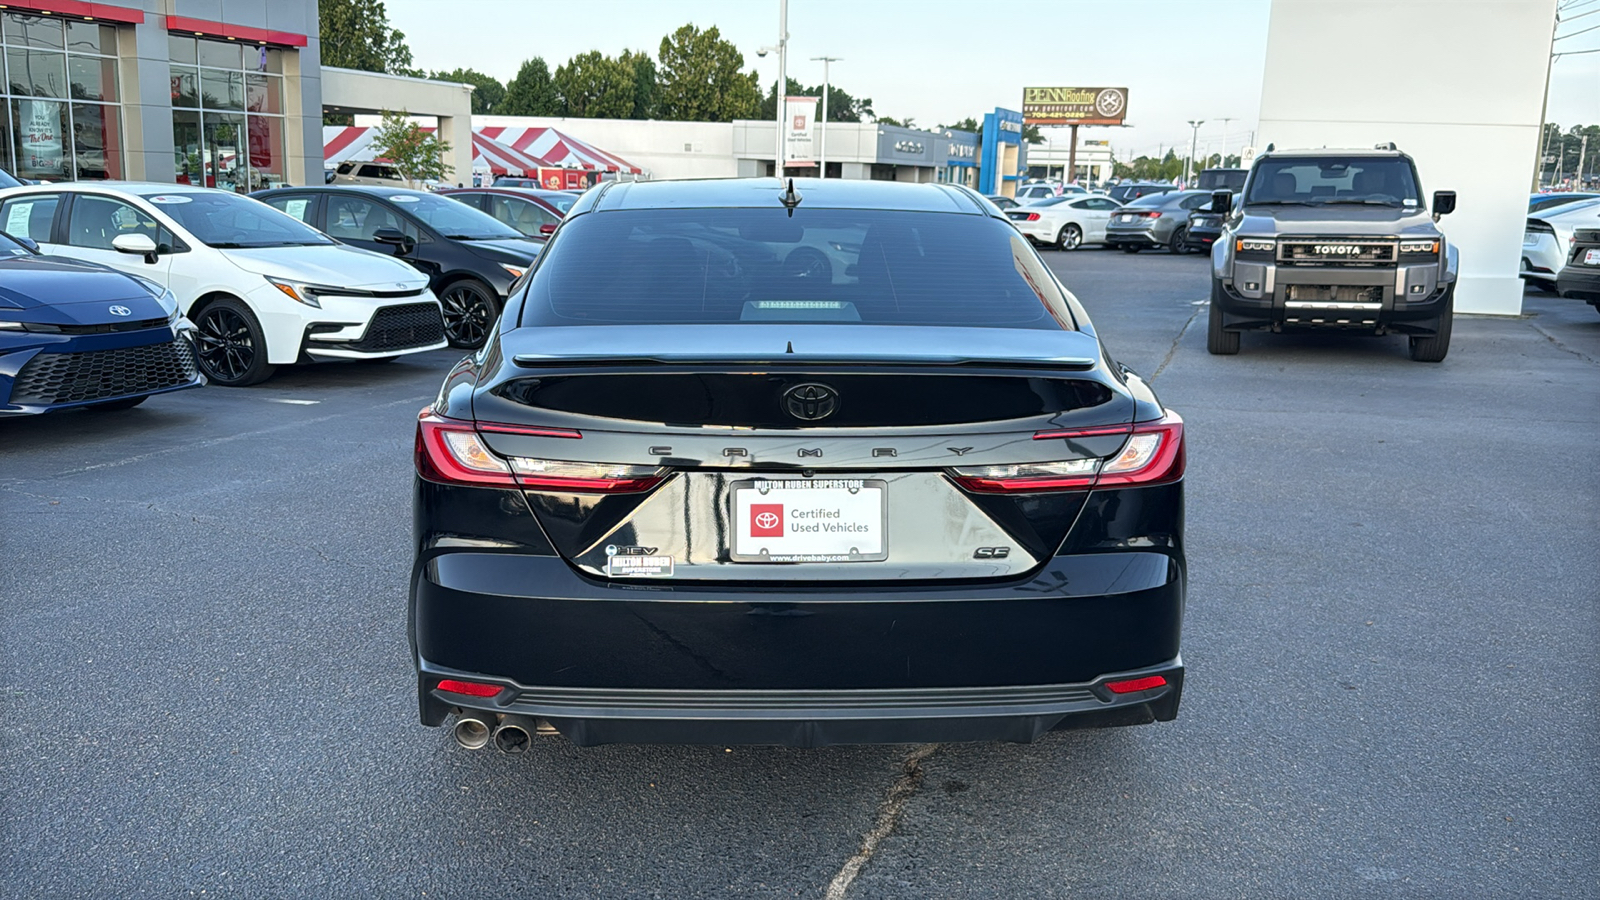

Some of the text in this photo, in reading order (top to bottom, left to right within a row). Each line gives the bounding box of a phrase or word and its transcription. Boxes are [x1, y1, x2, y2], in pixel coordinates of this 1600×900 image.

[1025, 88, 1068, 102] PENN
[1066, 90, 1095, 104] Roofing
[1314, 245, 1360, 254] TOYOTA
[648, 446, 975, 458] CAMRY
[754, 480, 864, 490] MILTON RUBEN SUPERSTORE
[791, 509, 840, 519] Certified
[791, 522, 869, 533] Used Vehicles
[770, 554, 850, 563] www.drivebaby.com
